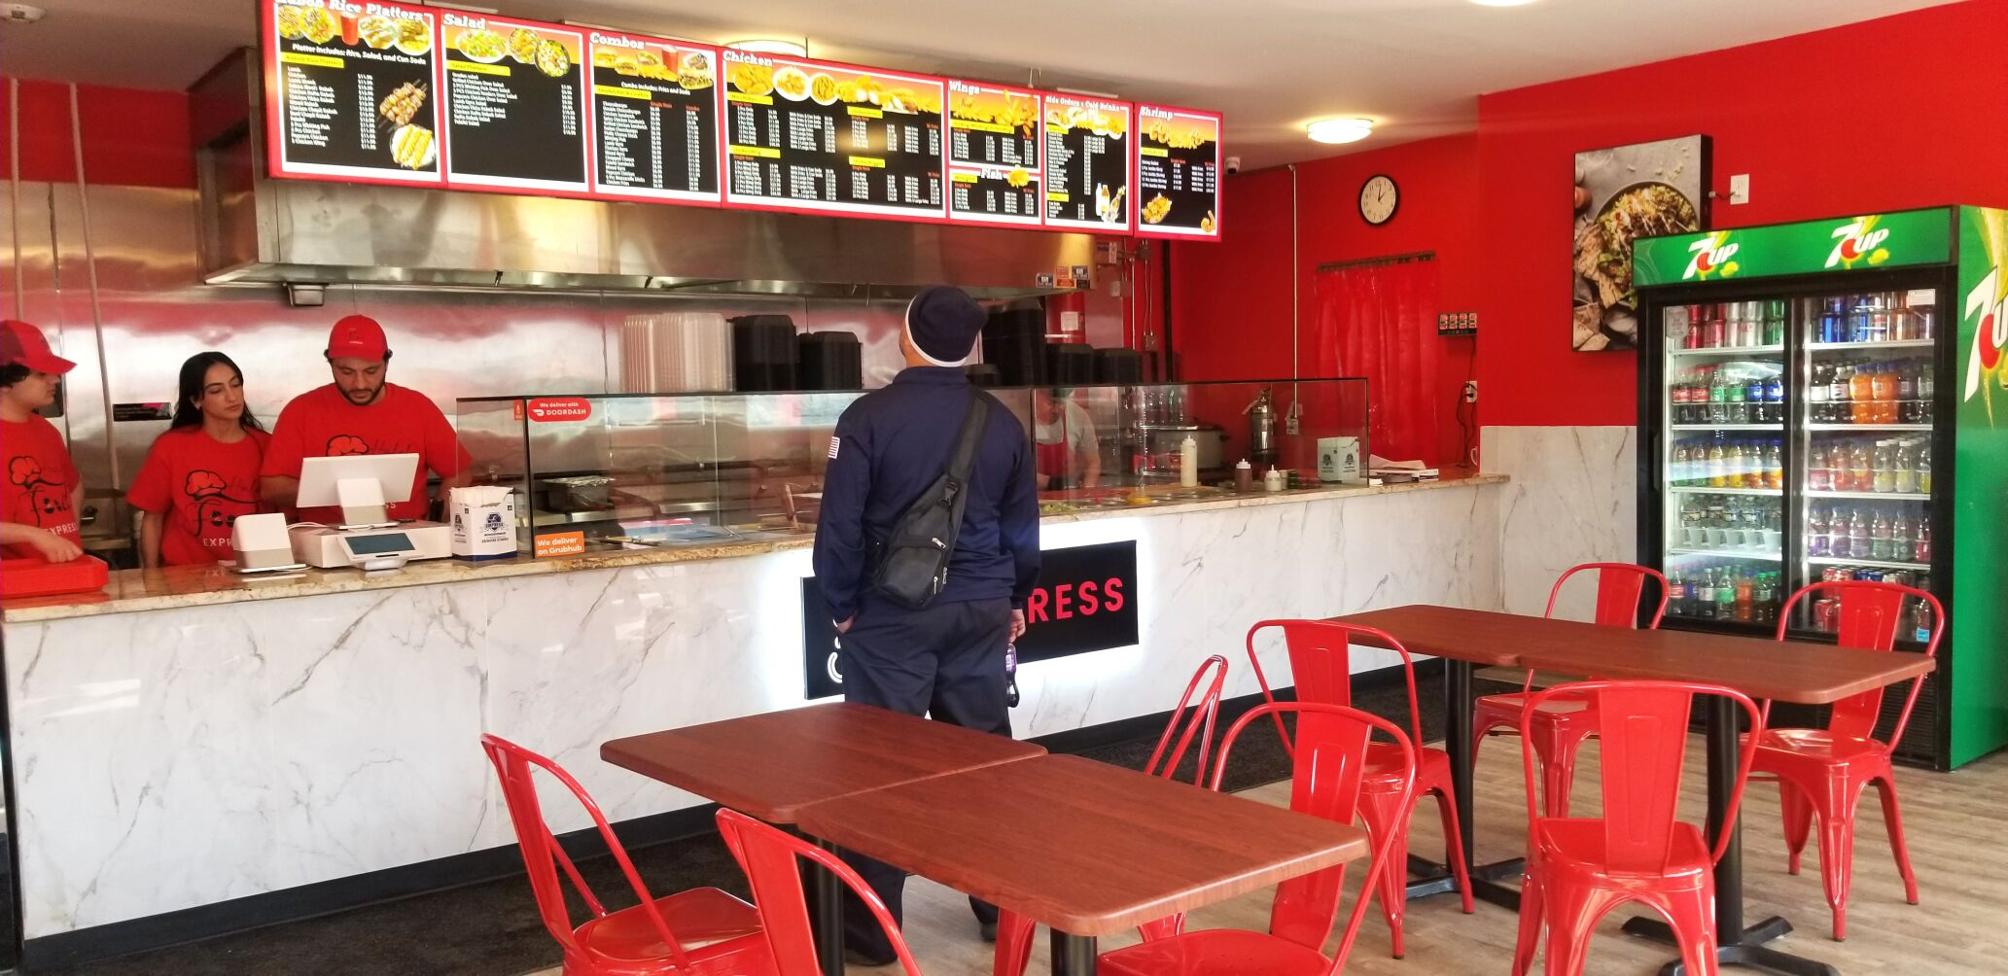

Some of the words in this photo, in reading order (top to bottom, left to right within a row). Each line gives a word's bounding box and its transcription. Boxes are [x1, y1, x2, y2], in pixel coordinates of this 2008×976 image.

[365, 3, 422, 20] Platters
[444, 14, 485, 29] Salad
[590, 32, 644, 49] Combos
[723, 50, 773, 67] Chicken
[949, 81, 980, 96] Wings
[1140, 106, 1173, 121] Shrimp
[552, 537, 577, 545] deliver
[549, 545, 582, 553] Grubhub
